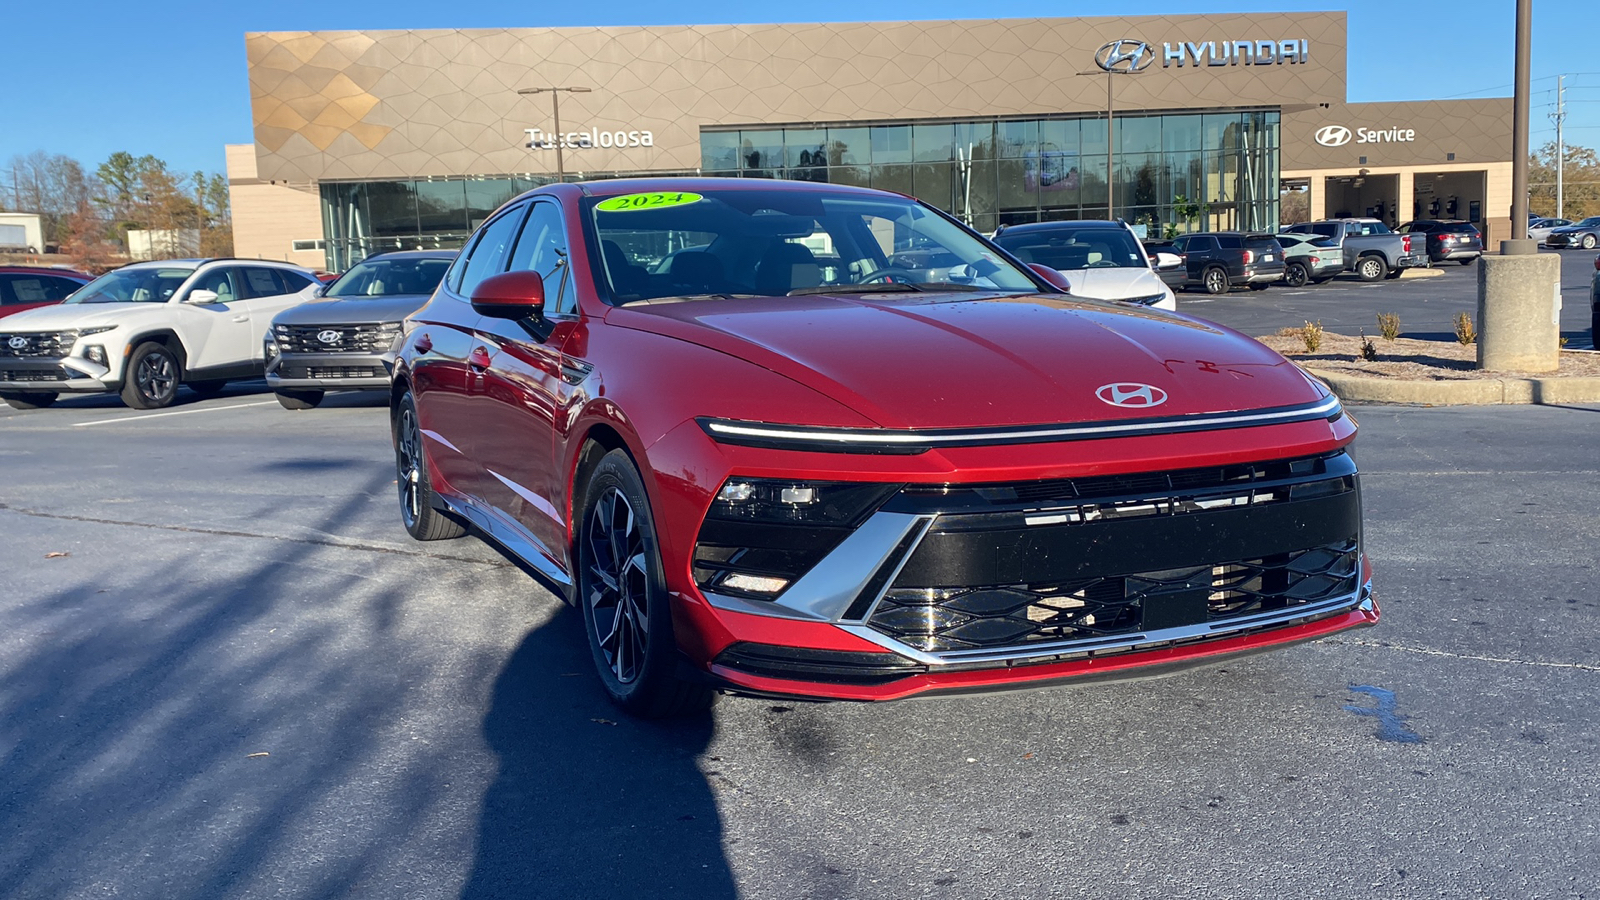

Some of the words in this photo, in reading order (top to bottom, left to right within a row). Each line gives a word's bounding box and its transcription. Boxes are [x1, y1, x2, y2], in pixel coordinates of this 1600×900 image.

[1163, 39, 1308, 68] HYUNDAI
[524, 126, 653, 150] Tuscaloosa
[1356, 125, 1415, 144] Service
[616, 193, 683, 210] 2024
